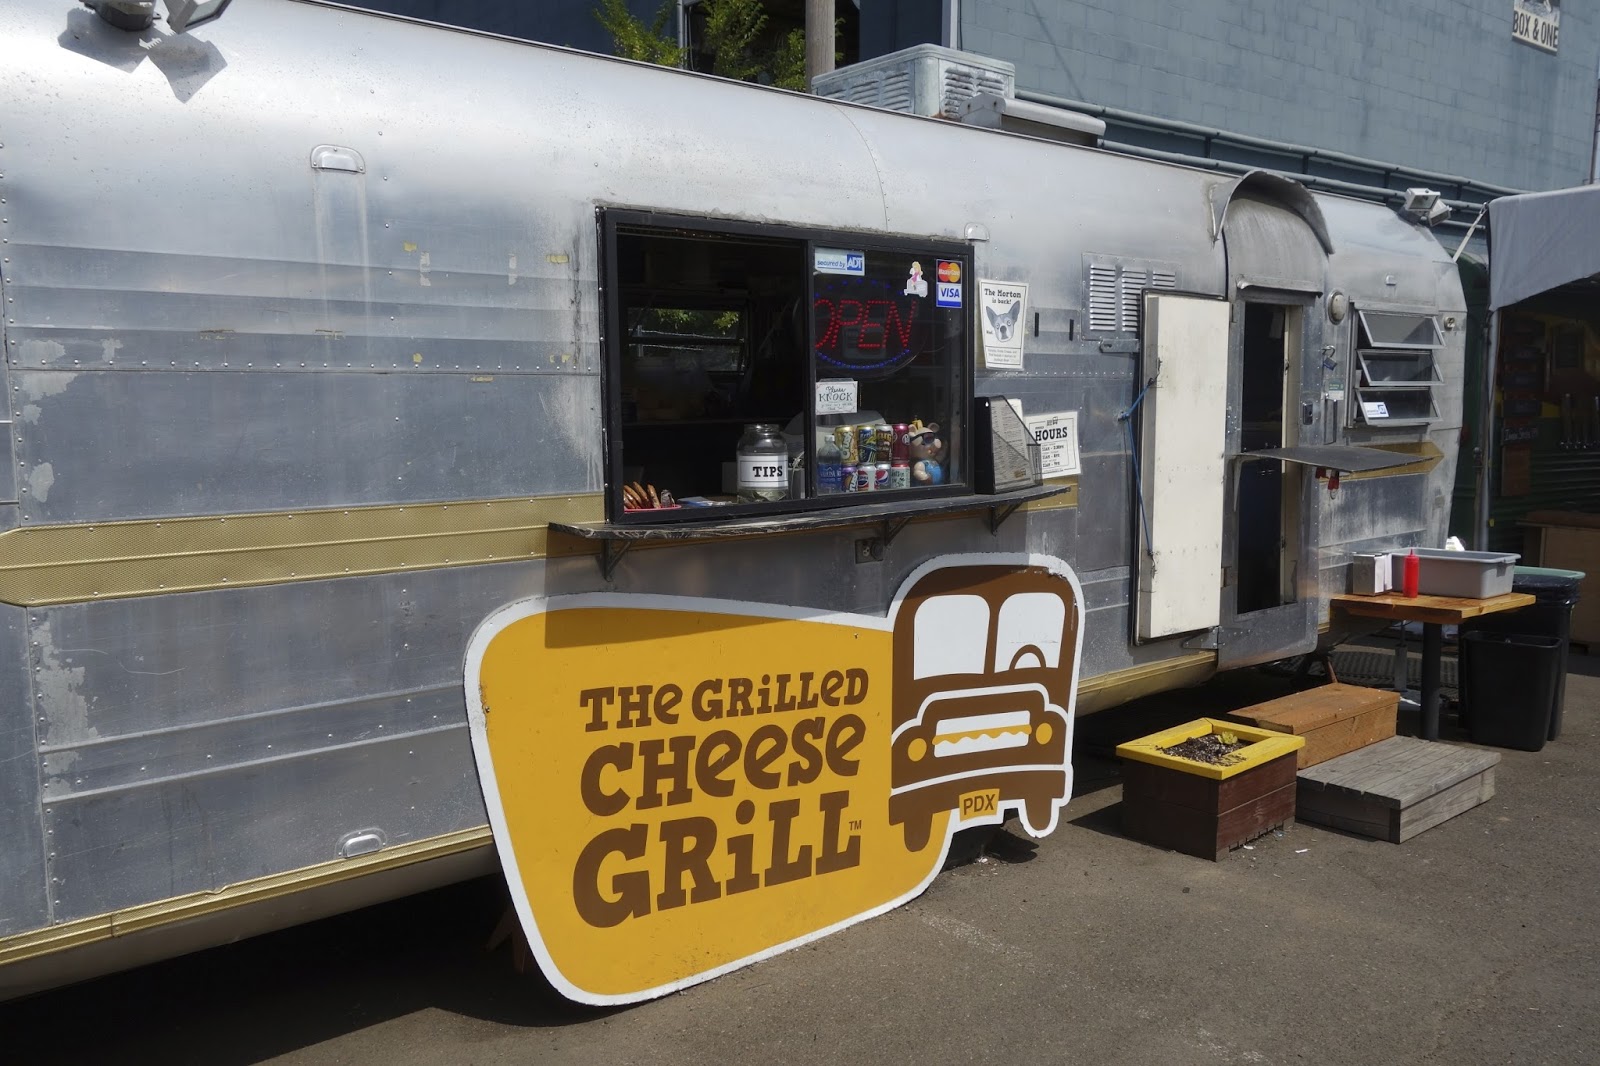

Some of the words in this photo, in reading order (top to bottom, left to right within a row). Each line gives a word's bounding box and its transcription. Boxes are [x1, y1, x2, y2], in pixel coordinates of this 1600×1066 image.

[1513, 10, 1531, 38] BOX
[1533, 18, 1540, 41] &
[1540, 21, 1559, 48] ONE
[817, 260, 838, 268] secured
[838, 261, 846, 269] by
[847, 255, 863, 271] ADT
[940, 287, 960, 298] VISA
[984, 288, 996, 297] The
[997, 289, 1021, 299] Morton
[819, 392, 853, 402] KNOCK
[1035, 426, 1068, 442] HOURS
[753, 465, 783, 478] TIPS
[963, 793, 996, 816] PDX
[849, 820, 862, 831] TM
